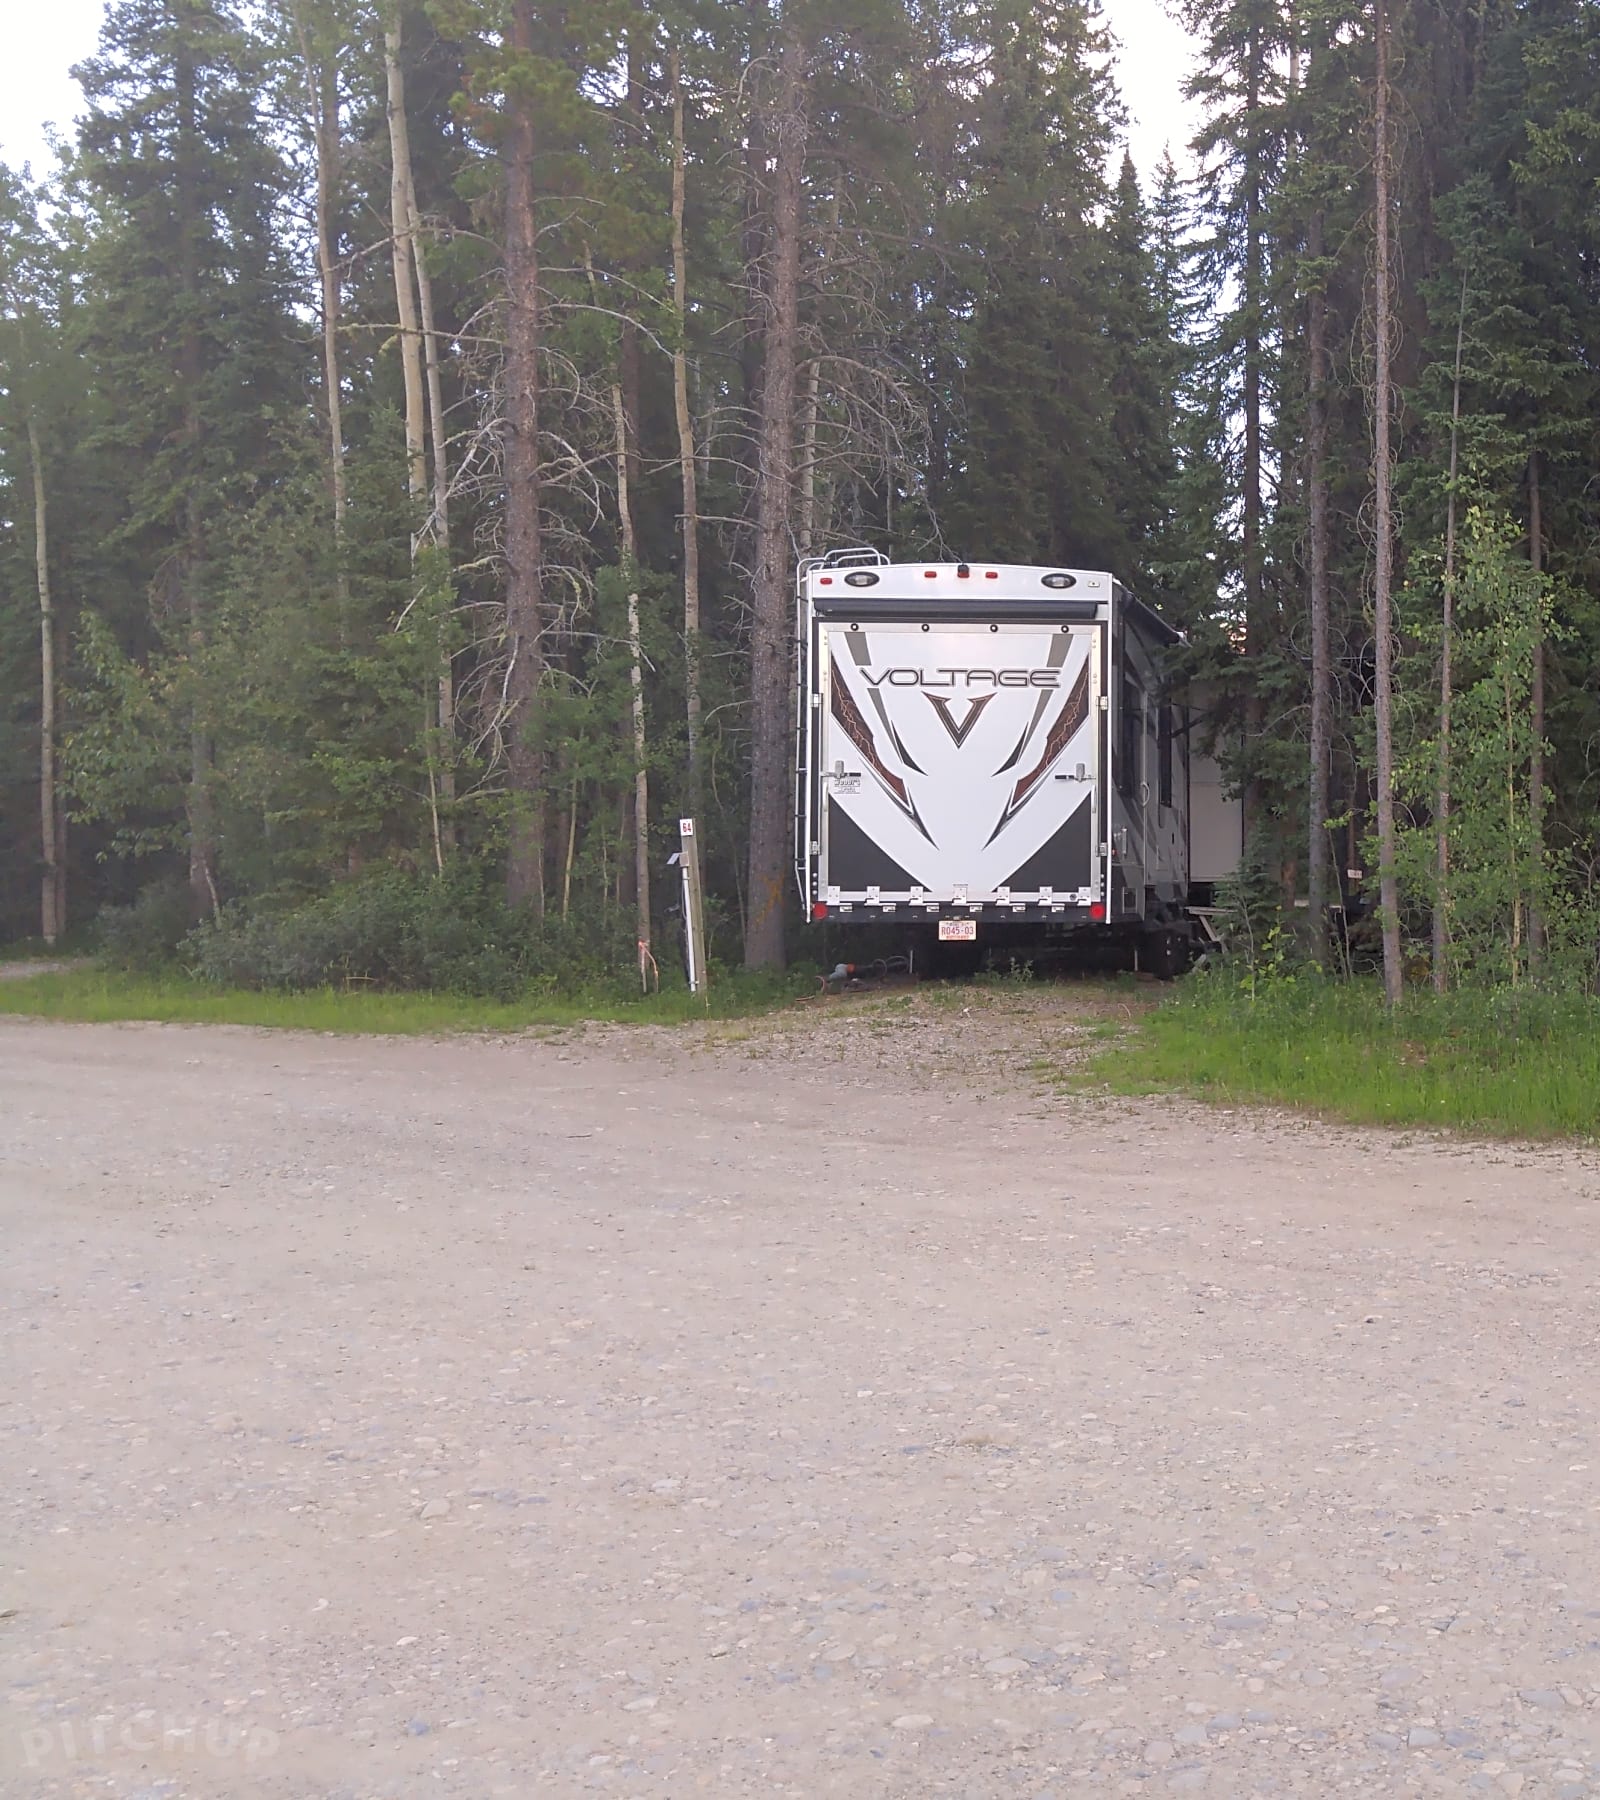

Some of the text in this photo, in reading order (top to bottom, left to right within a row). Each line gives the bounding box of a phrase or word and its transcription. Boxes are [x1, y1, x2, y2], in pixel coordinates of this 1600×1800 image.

[859, 667, 1061, 688] VOLTAGE
[921, 690, 998, 749] V
[682, 822, 691, 833] 64
